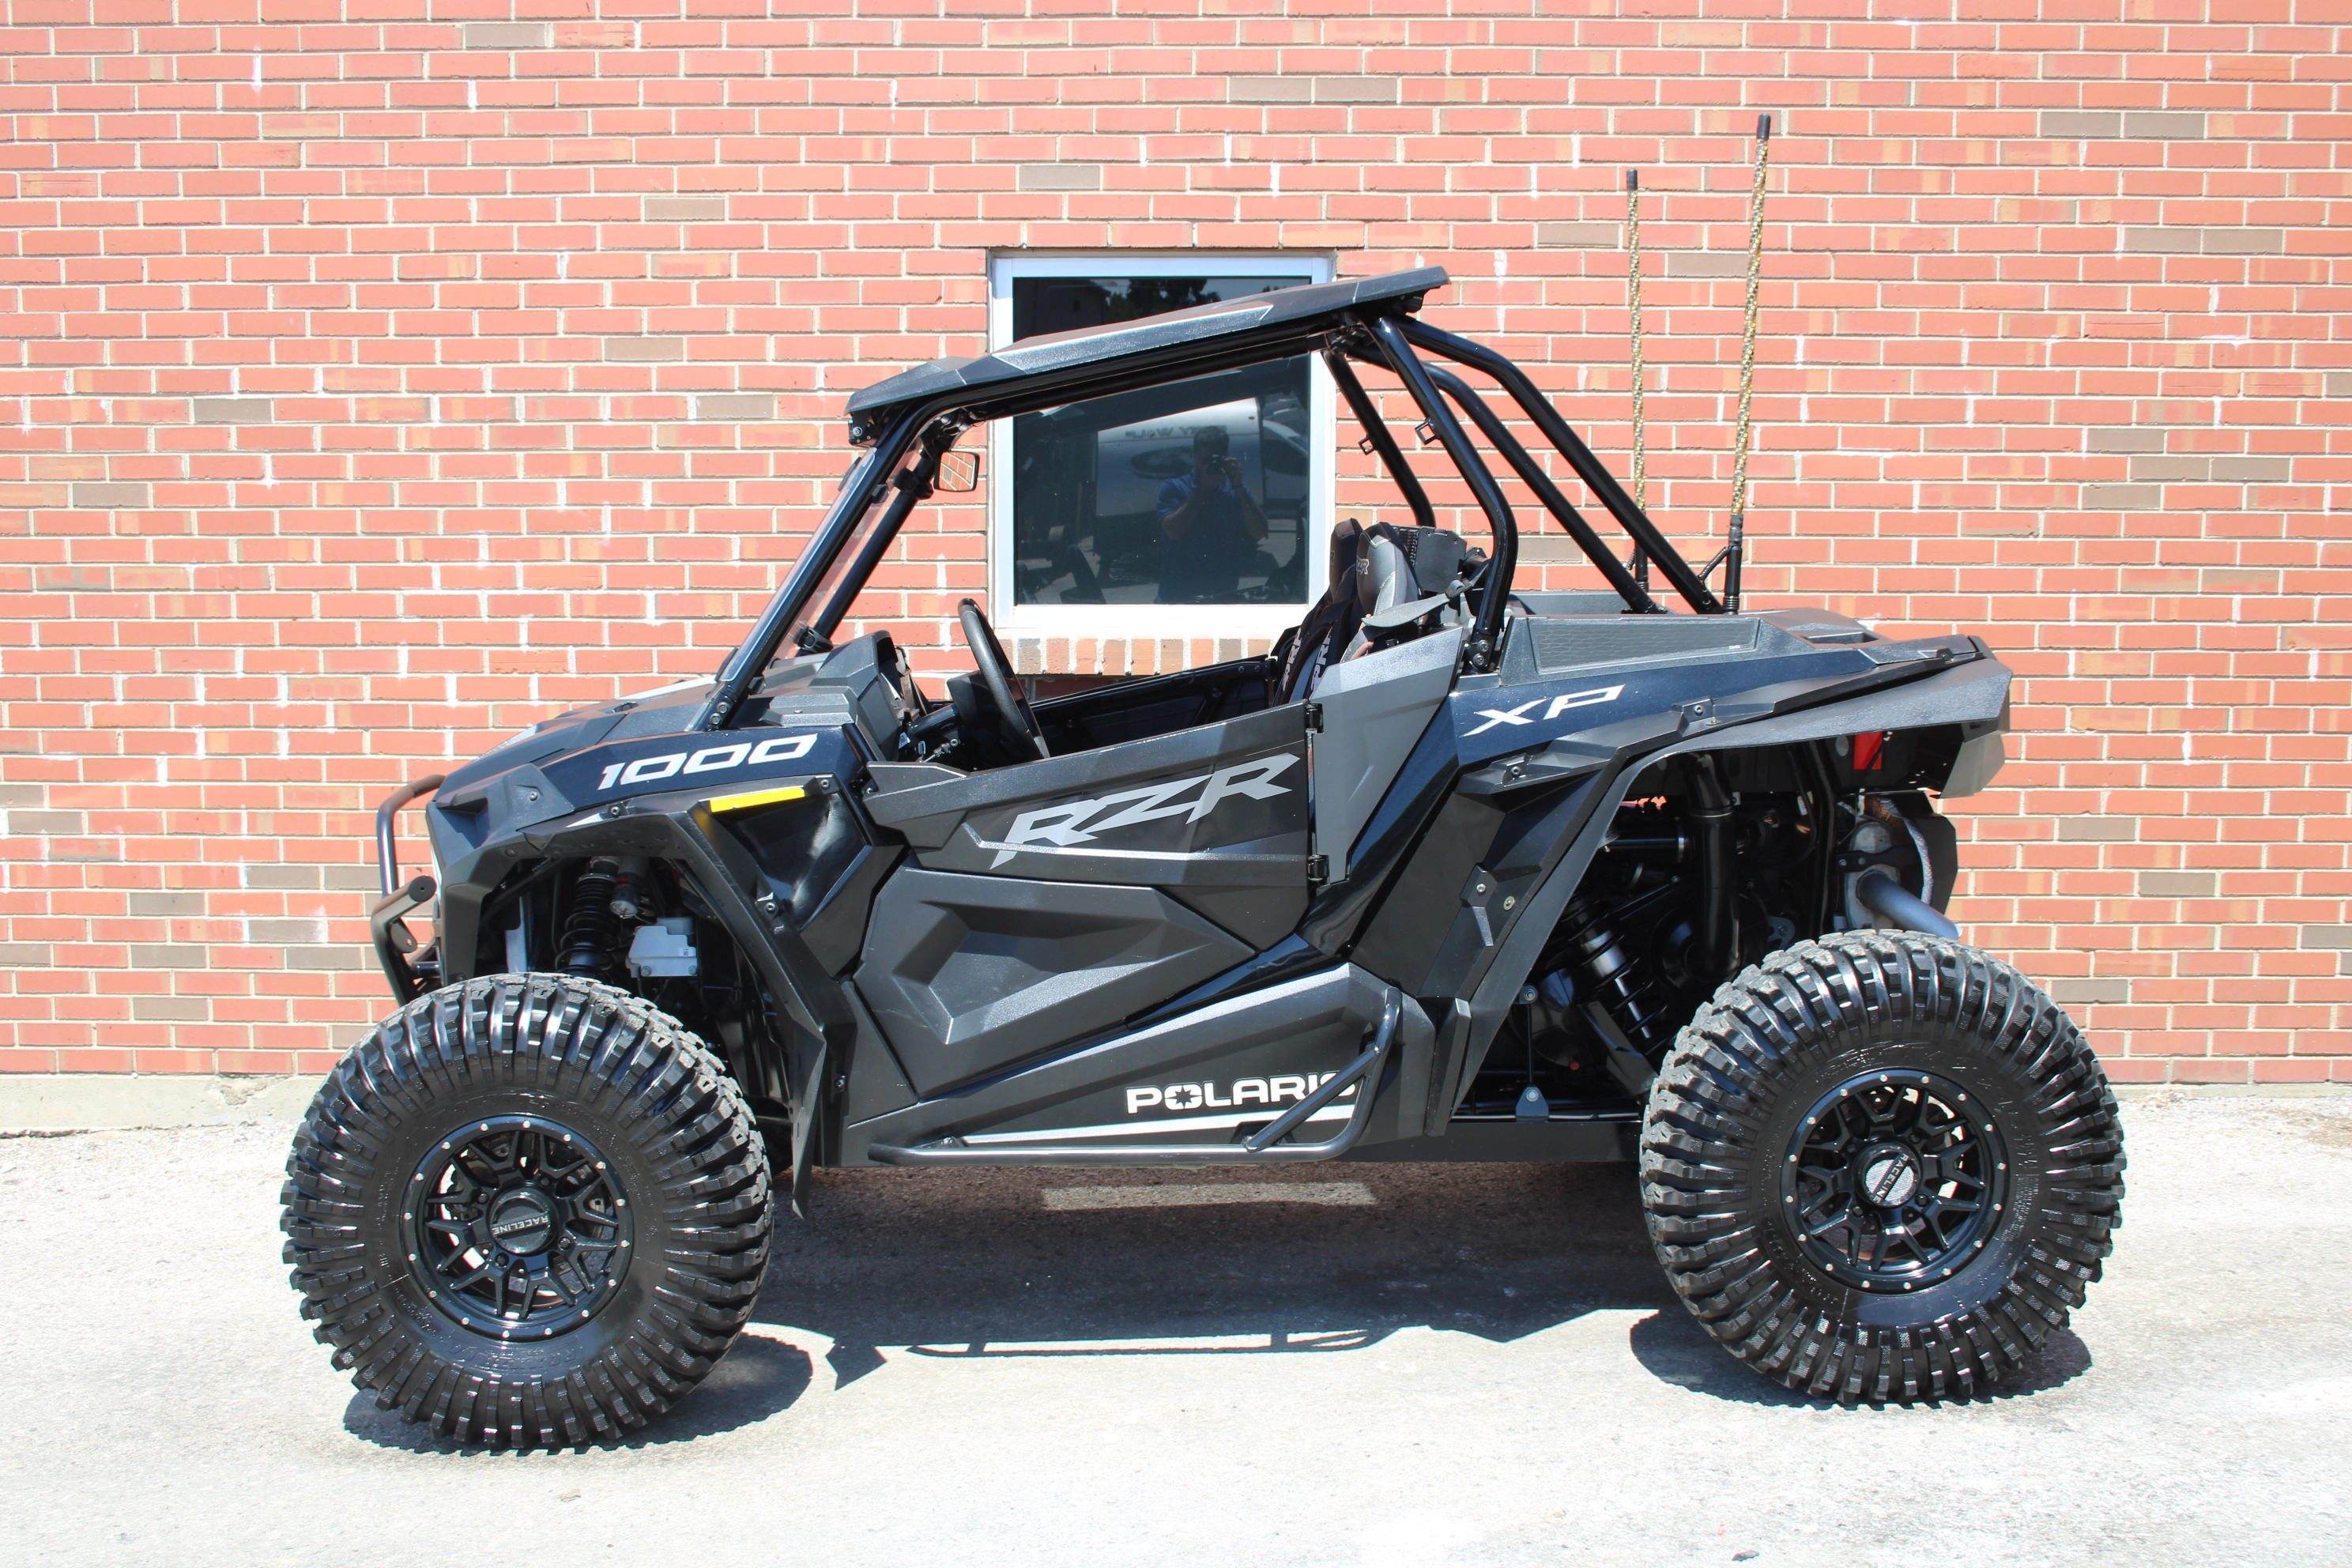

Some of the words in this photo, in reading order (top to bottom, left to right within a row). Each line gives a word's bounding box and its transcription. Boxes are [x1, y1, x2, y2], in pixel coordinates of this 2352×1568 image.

[1459, 684, 1626, 737] XP
[597, 733, 819, 790] 1000
[989, 752, 1301, 869] RZR
[1872, 1153, 1909, 1203] RACELINE
[492, 1215, 549, 1235] RACELINE
